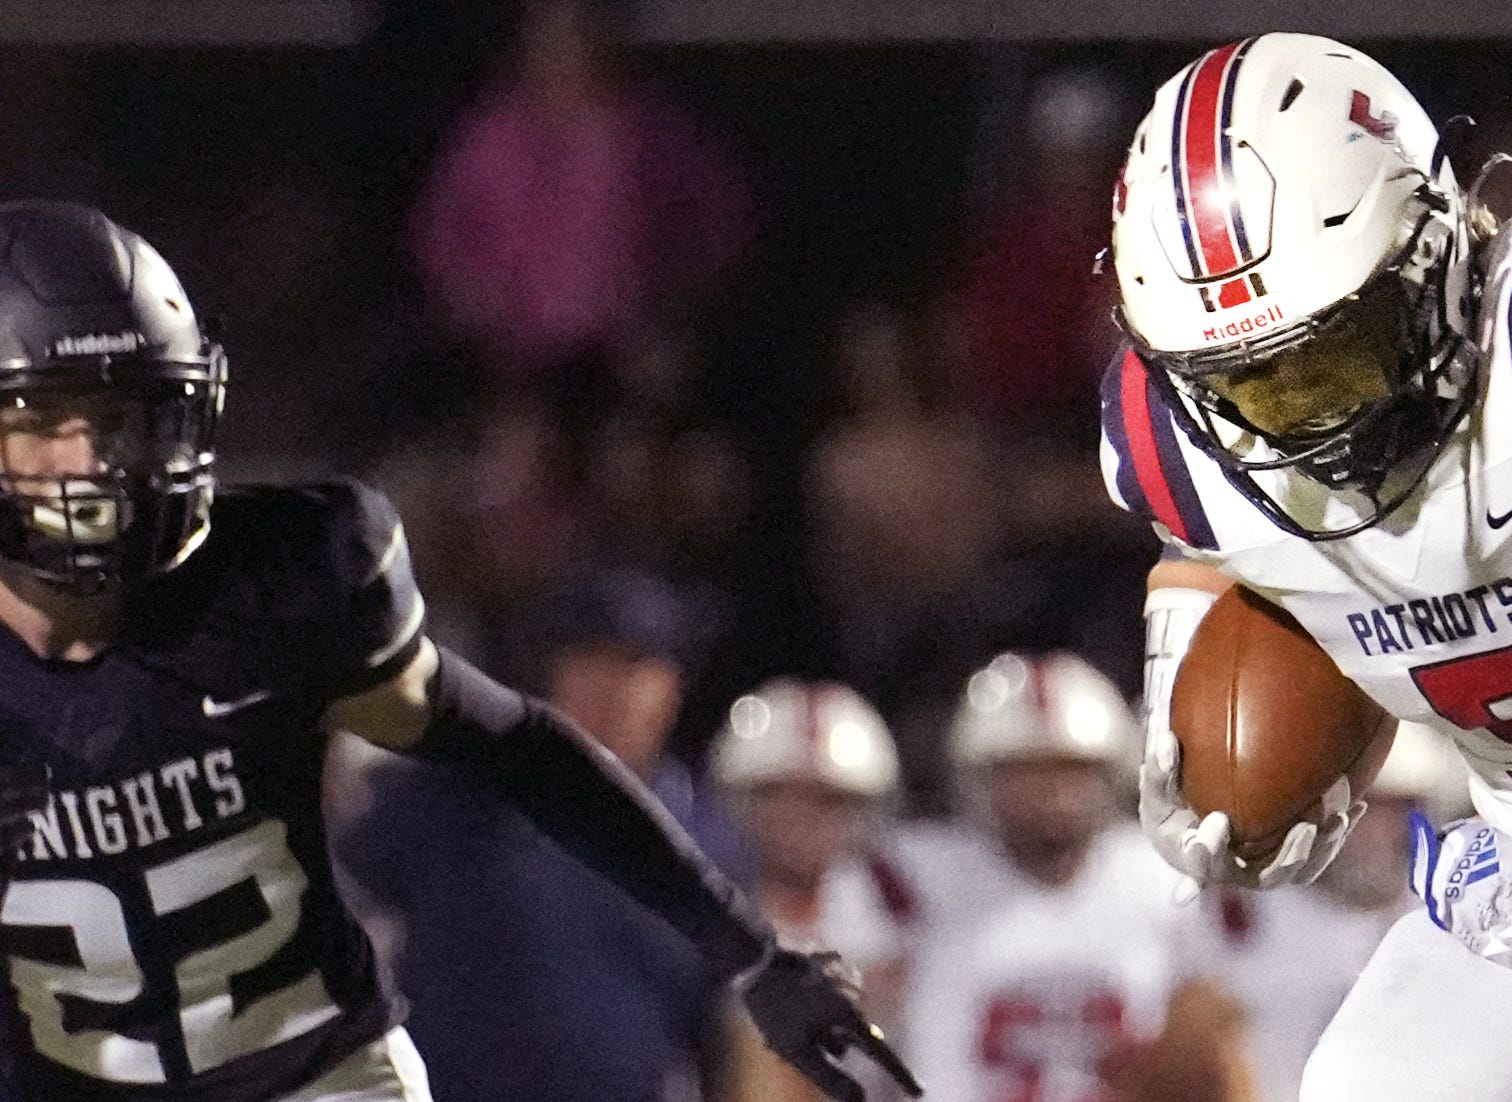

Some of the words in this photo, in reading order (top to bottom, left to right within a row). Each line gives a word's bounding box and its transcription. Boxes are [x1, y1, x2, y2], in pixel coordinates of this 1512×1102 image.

[1203, 304, 1284, 341] Riddell
[16, 747, 246, 861] NIGHTS
[1445, 827, 1490, 899] adidas
[0, 817, 343, 1084] 22
